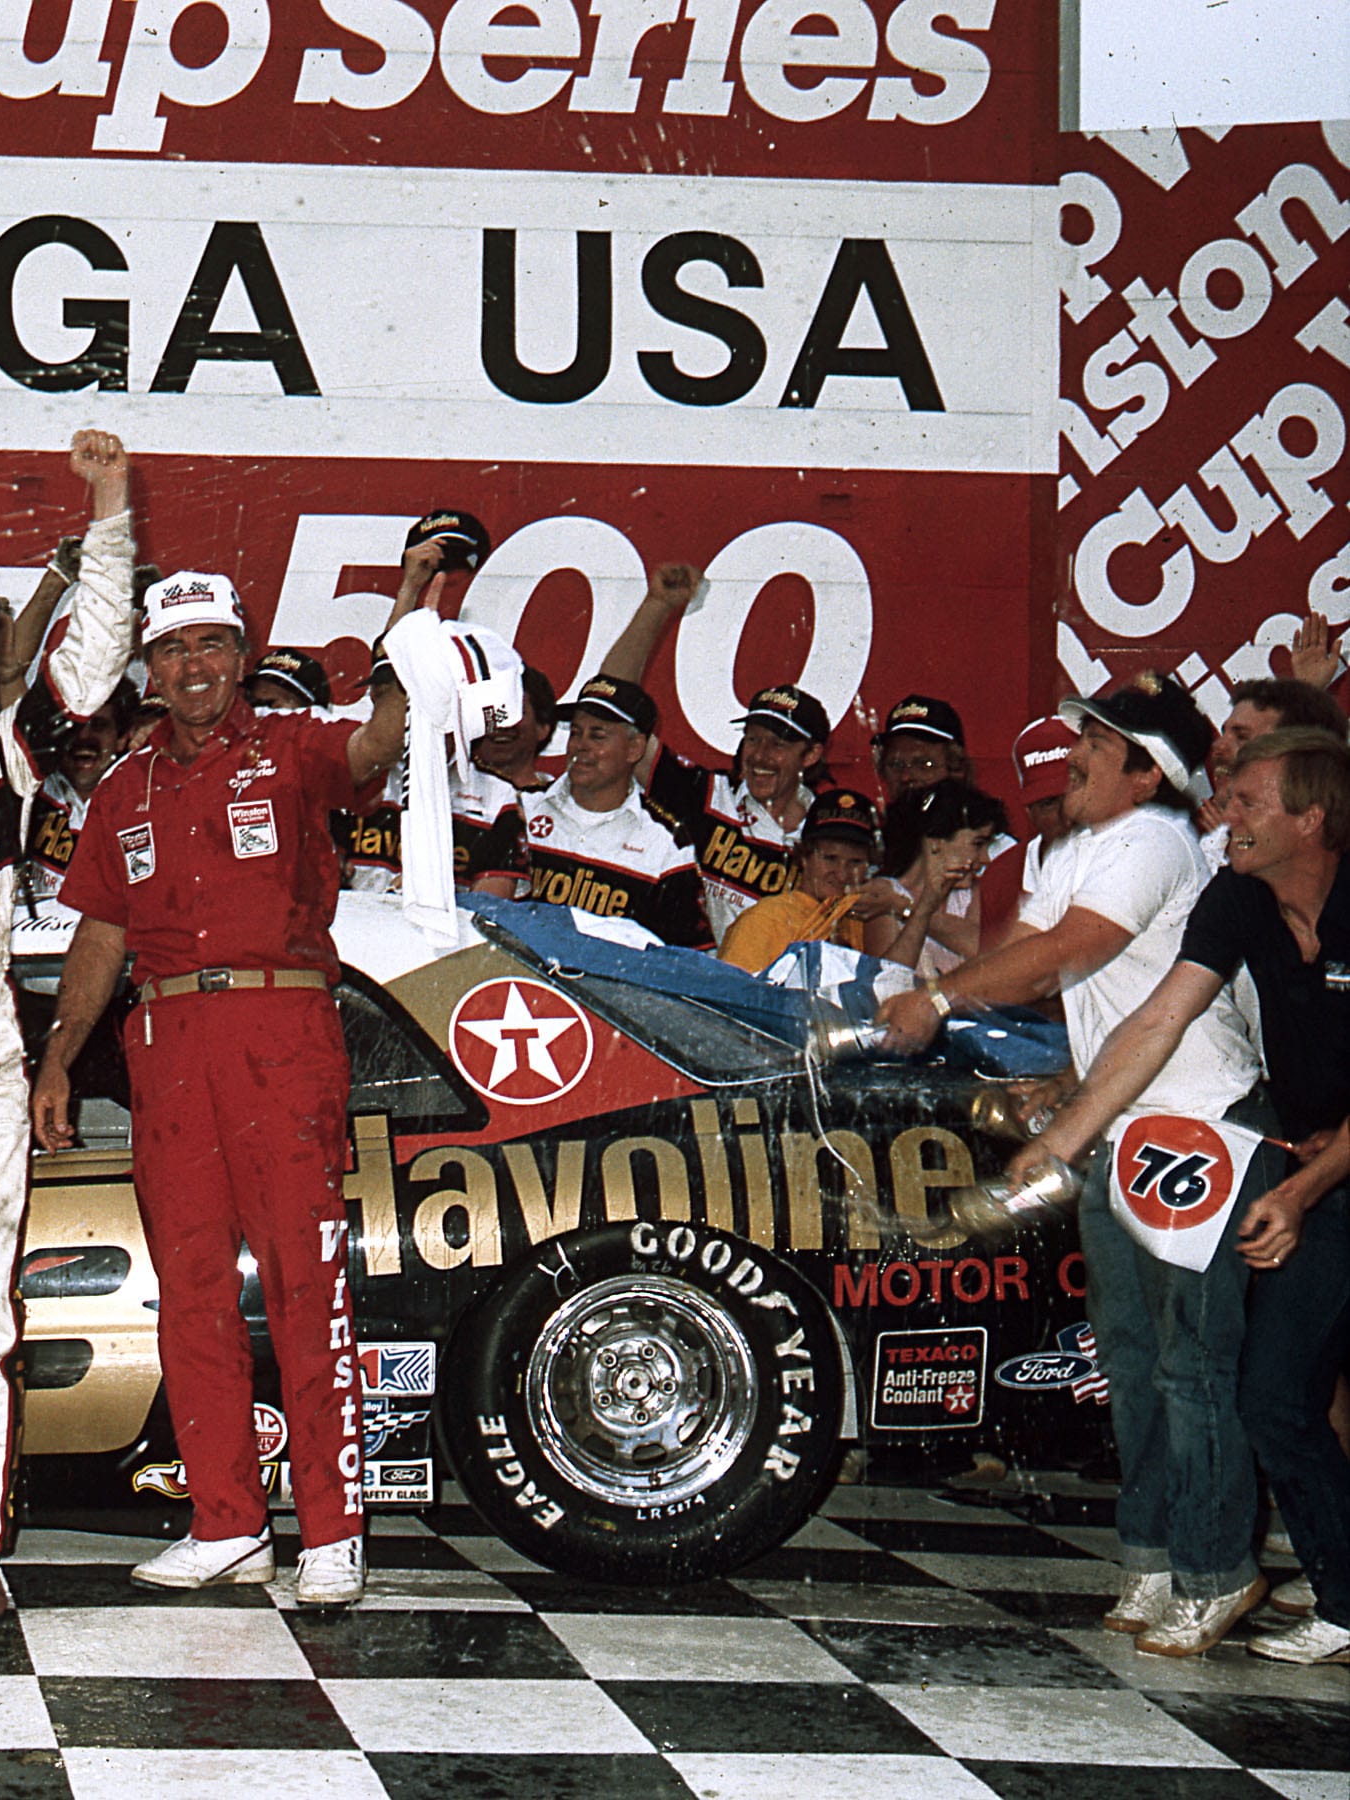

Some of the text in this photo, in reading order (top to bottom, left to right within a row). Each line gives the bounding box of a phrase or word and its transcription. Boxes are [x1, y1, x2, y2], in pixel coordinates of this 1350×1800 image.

[296, 0, 994, 126] Series
[480, 227, 947, 413] USA
[1074, 382, 1346, 639] Cup
[267, 513, 874, 759] 500
[528, 866, 631, 917] voline
[1129, 1143, 1218, 1211] 76
[833, 1255, 1031, 1308] MOTOR
[883, 1368, 977, 1387] Anti-Freeze
[885, 1344, 978, 1364] TEXACO
[1014, 1355, 1077, 1381] Ford
[881, 1385, 943, 1404] Coolant
[363, 1489, 428, 1500] AFETY GLASS
[476, 1414, 566, 1530] EAGLE
